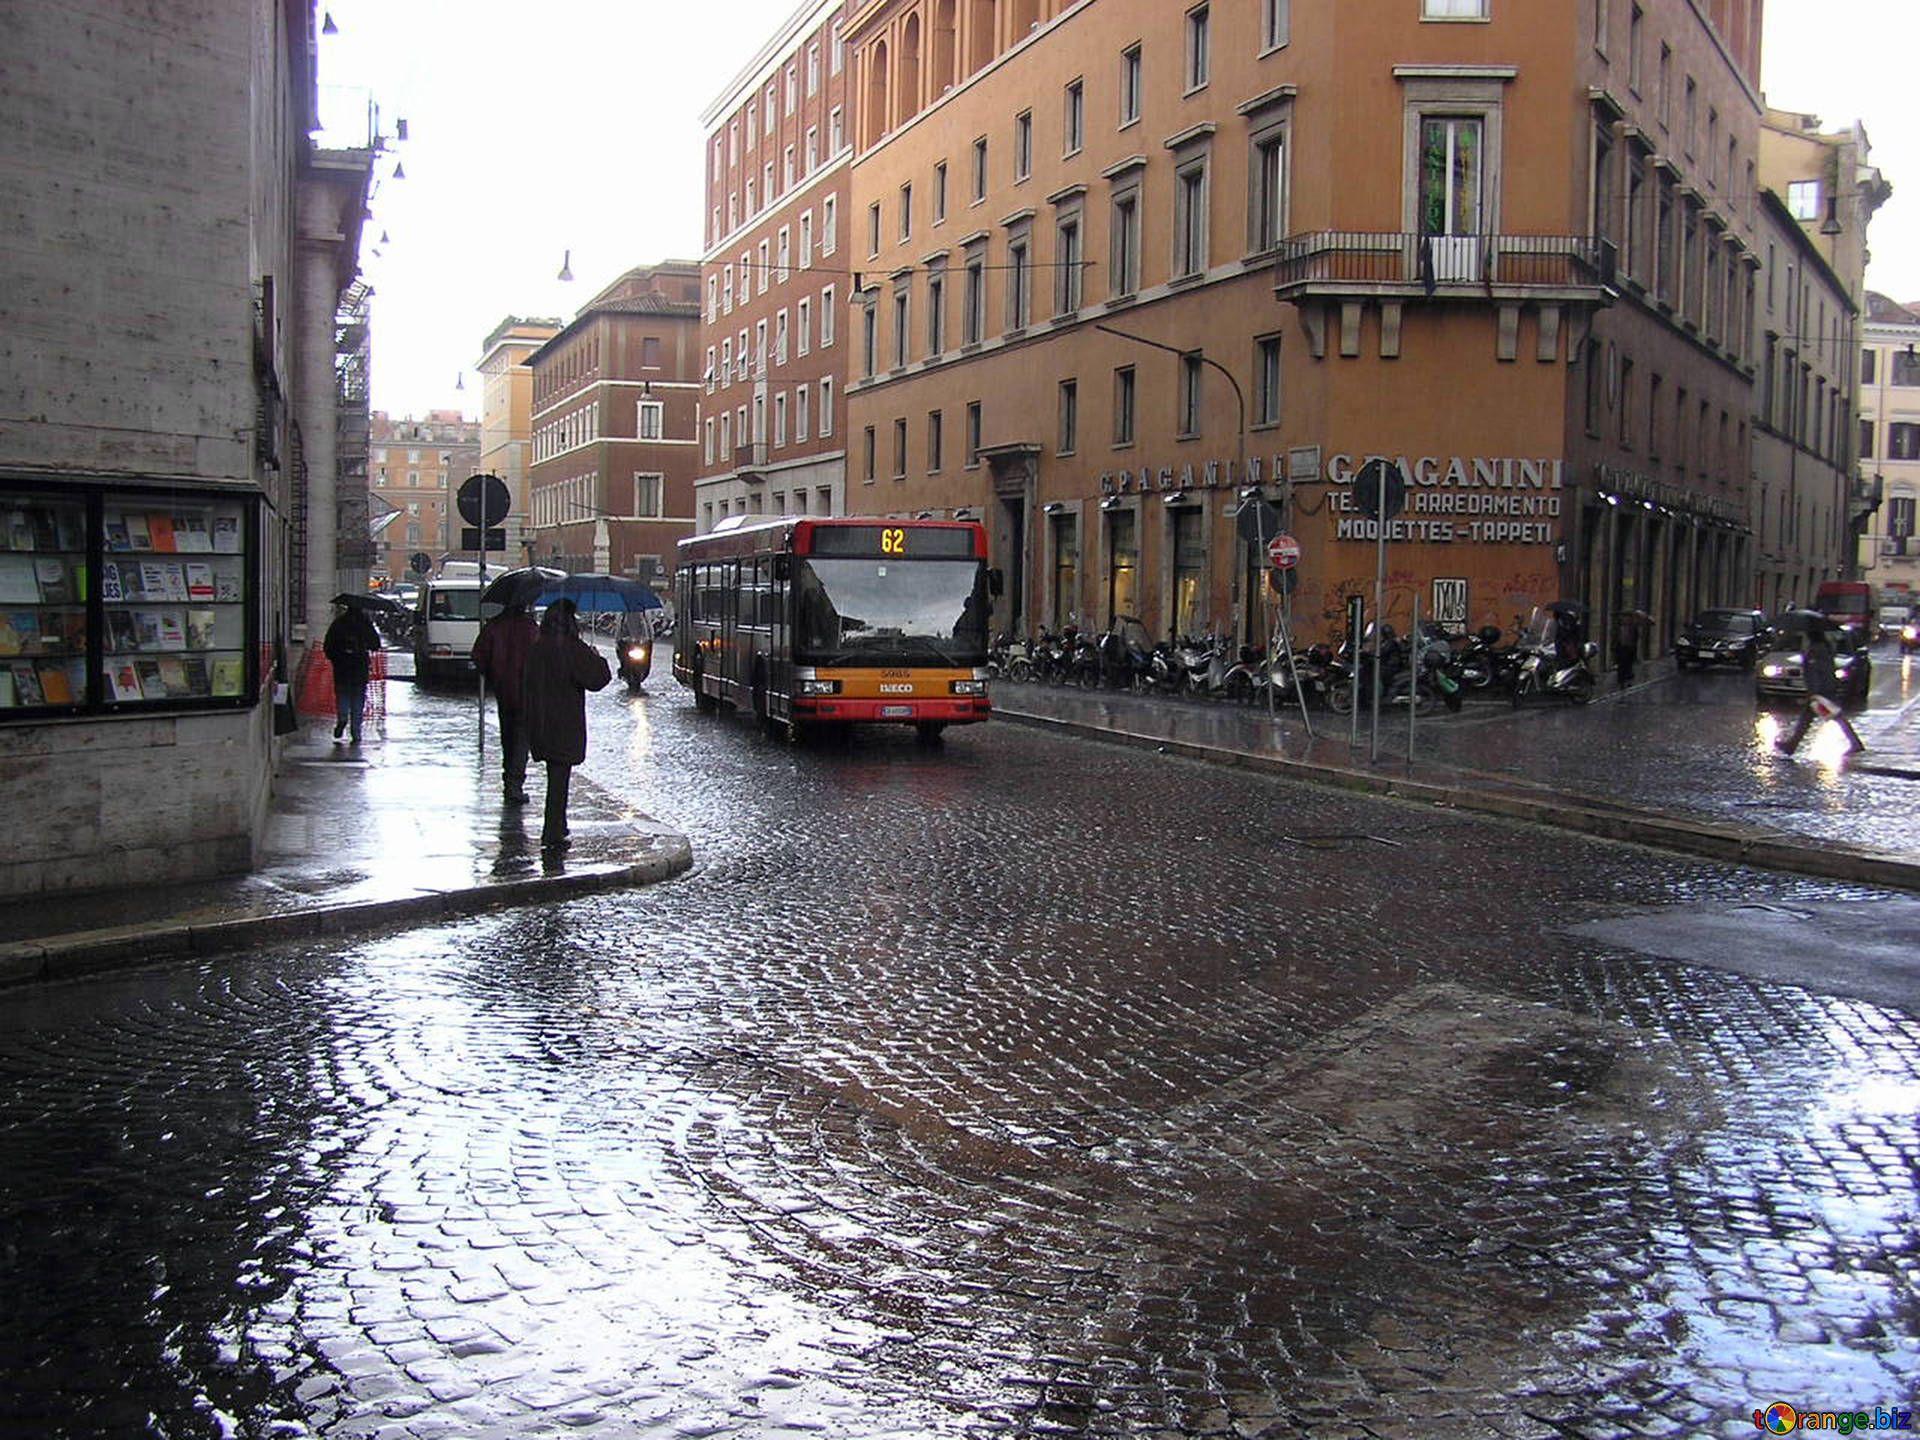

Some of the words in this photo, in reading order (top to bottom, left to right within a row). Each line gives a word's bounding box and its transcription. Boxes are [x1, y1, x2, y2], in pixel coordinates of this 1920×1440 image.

[1415, 493, 1561, 516] ARREDAMENTO
[881, 528, 904, 553] 62
[879, 683, 913, 693] IVECO
